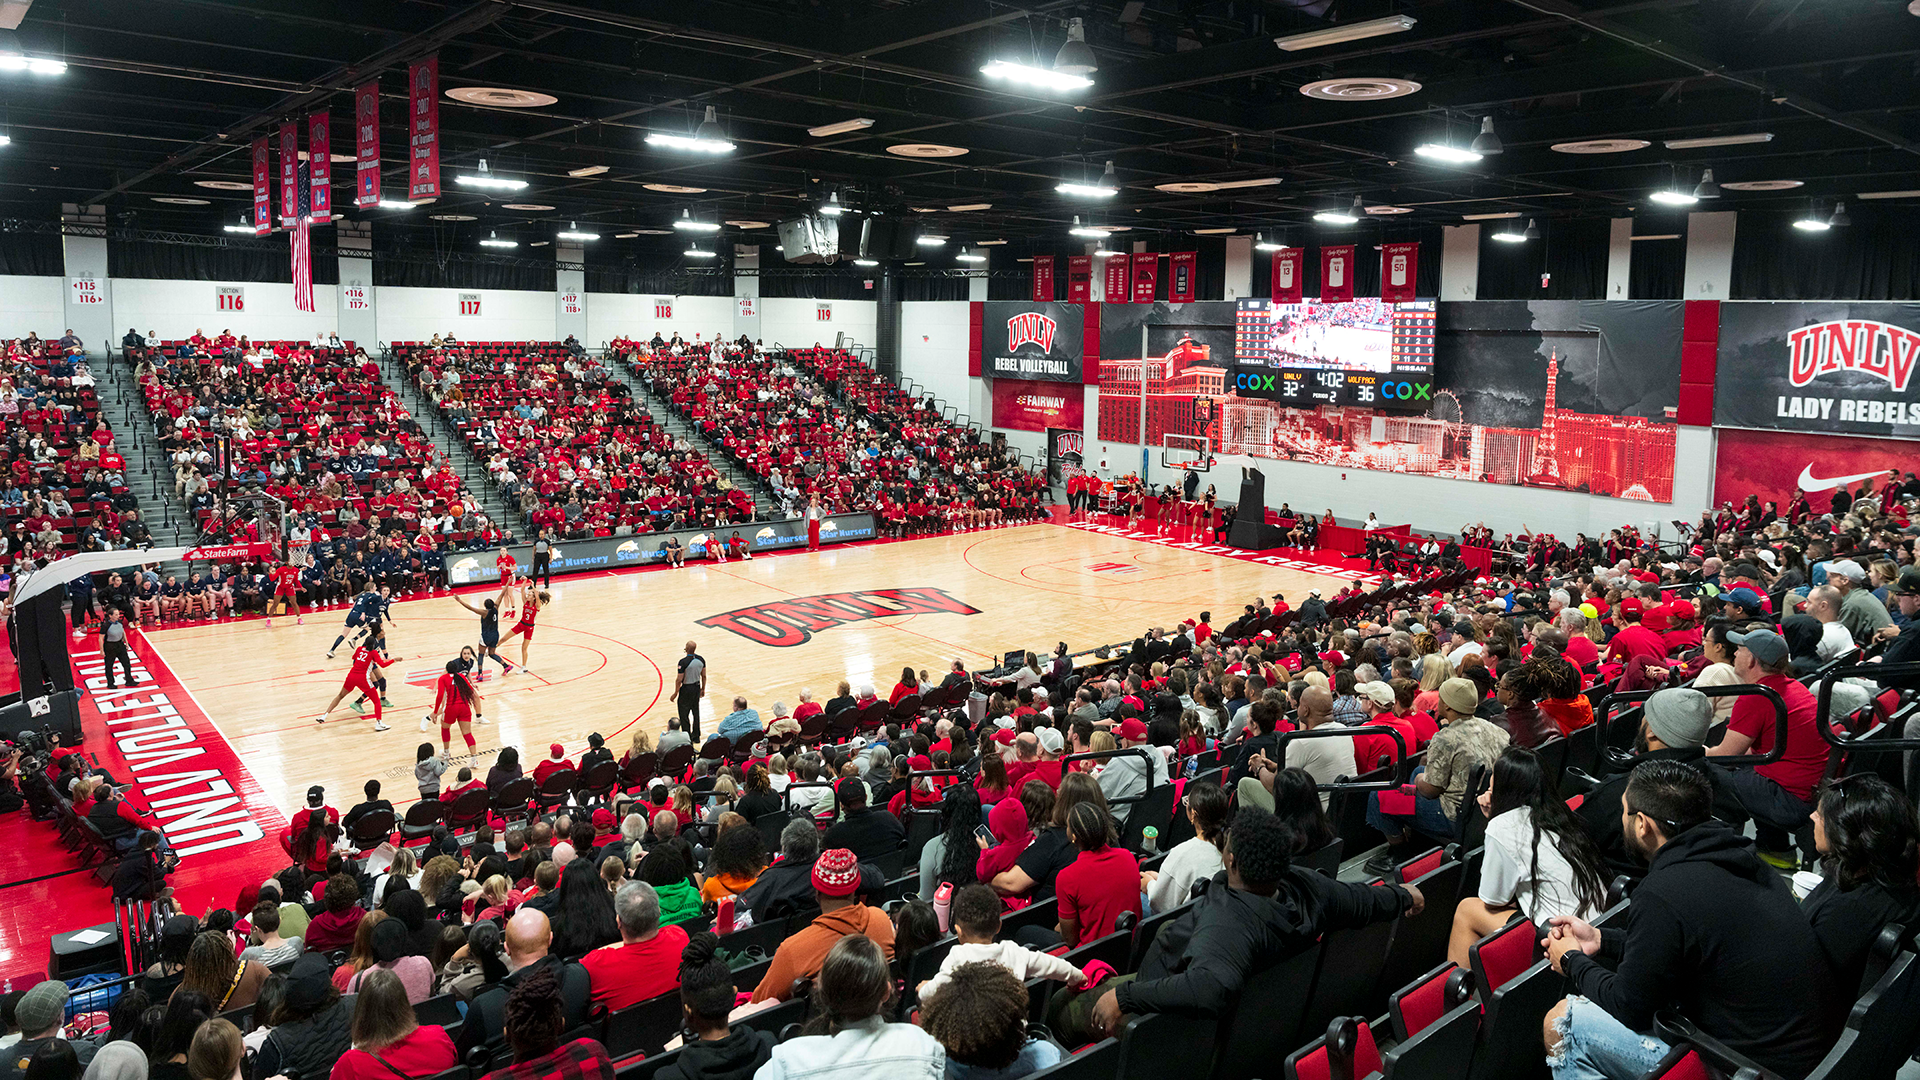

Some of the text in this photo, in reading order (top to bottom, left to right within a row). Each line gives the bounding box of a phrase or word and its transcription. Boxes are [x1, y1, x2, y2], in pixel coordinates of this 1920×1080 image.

[416, 97, 430, 115] 2017
[1334, 265, 1339, 273] 4
[1394, 264, 1404, 272] 50
[79, 282, 95, 290] 115
[79, 295, 96, 303] 116
[219, 294, 244, 310] 116
[460, 301, 480, 314] 117
[656, 305, 671, 318] 118
[818, 309, 831, 320] 119
[1008, 312, 1056, 354] UNLV
[1787, 319, 1920, 392] UNLV
[995, 358, 1018, 371] REBEL
[1020, 360, 1068, 374] VOLLEYBALL
[1236, 373, 1275, 391] COX
[1316, 372, 1344, 388] 4:02
[1284, 382, 1298, 396] 32
[1358, 386, 1374, 401] 36
[1381, 381, 1430, 400] COX
[1027, 395, 1065, 408] FAIRWAY
[1329, 391, 1337, 402] 2
[1777, 396, 1834, 420] LADY
[1840, 400, 1920, 424] REBELS
[757, 534, 808, 546] Star Nurser
[820, 528, 871, 539] Star Nursery
[1065, 522, 1158, 538] UNLV
[1150, 538, 1258, 556] LADY
[617, 551, 640, 560] Star
[689, 544, 706, 554] Sta
[565, 555, 608, 567] Nursery
[694, 587, 984, 647] UNLV
[357, 651, 368, 662] 32
[134, 768, 266, 858] UNLV
